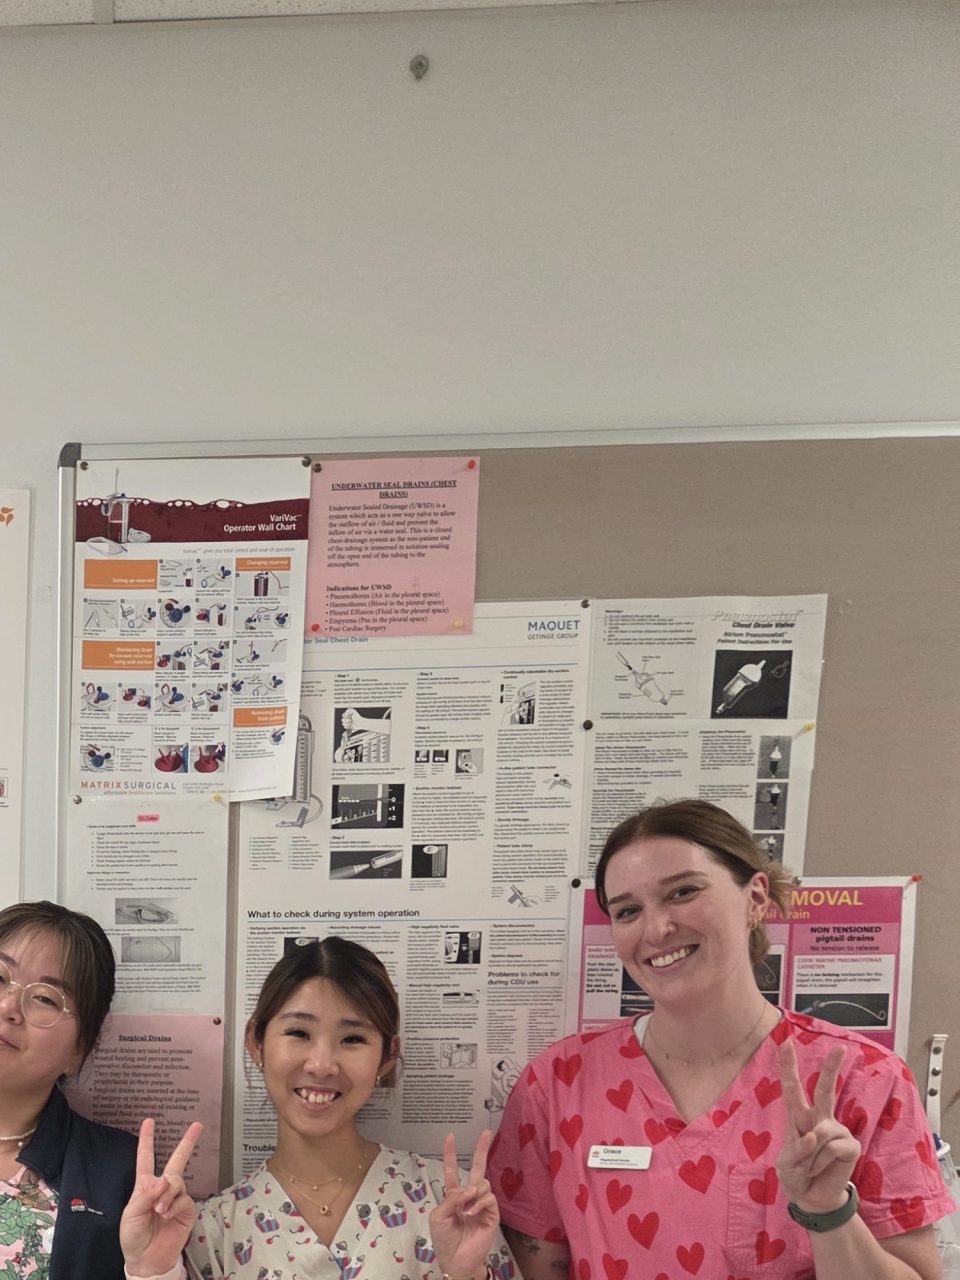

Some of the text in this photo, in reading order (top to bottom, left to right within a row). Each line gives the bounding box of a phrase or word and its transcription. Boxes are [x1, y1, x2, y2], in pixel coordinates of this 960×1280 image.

[331, 482, 382, 490] UNDERWATER
[430, 480, 457, 488] (CHEST
[379, 491, 408, 499] DRAINS)
[223, 524, 256, 534] Operator
[257, 523, 274, 531] Wall
[405, 599, 425, 607] pleural
[410, 607, 430, 615] pleural
[528, 620, 581, 631] MAQUET
[791, 890, 864, 906] MOVAL
[248, 910, 271, 919] What
[284, 909, 311, 918] check
[313, 909, 341, 919] during
[343, 910, 375, 919] system
[378, 909, 420, 919] operation
[816, 935, 844, 943] pigtail
[242, 1144, 277, 1152] Trouble
